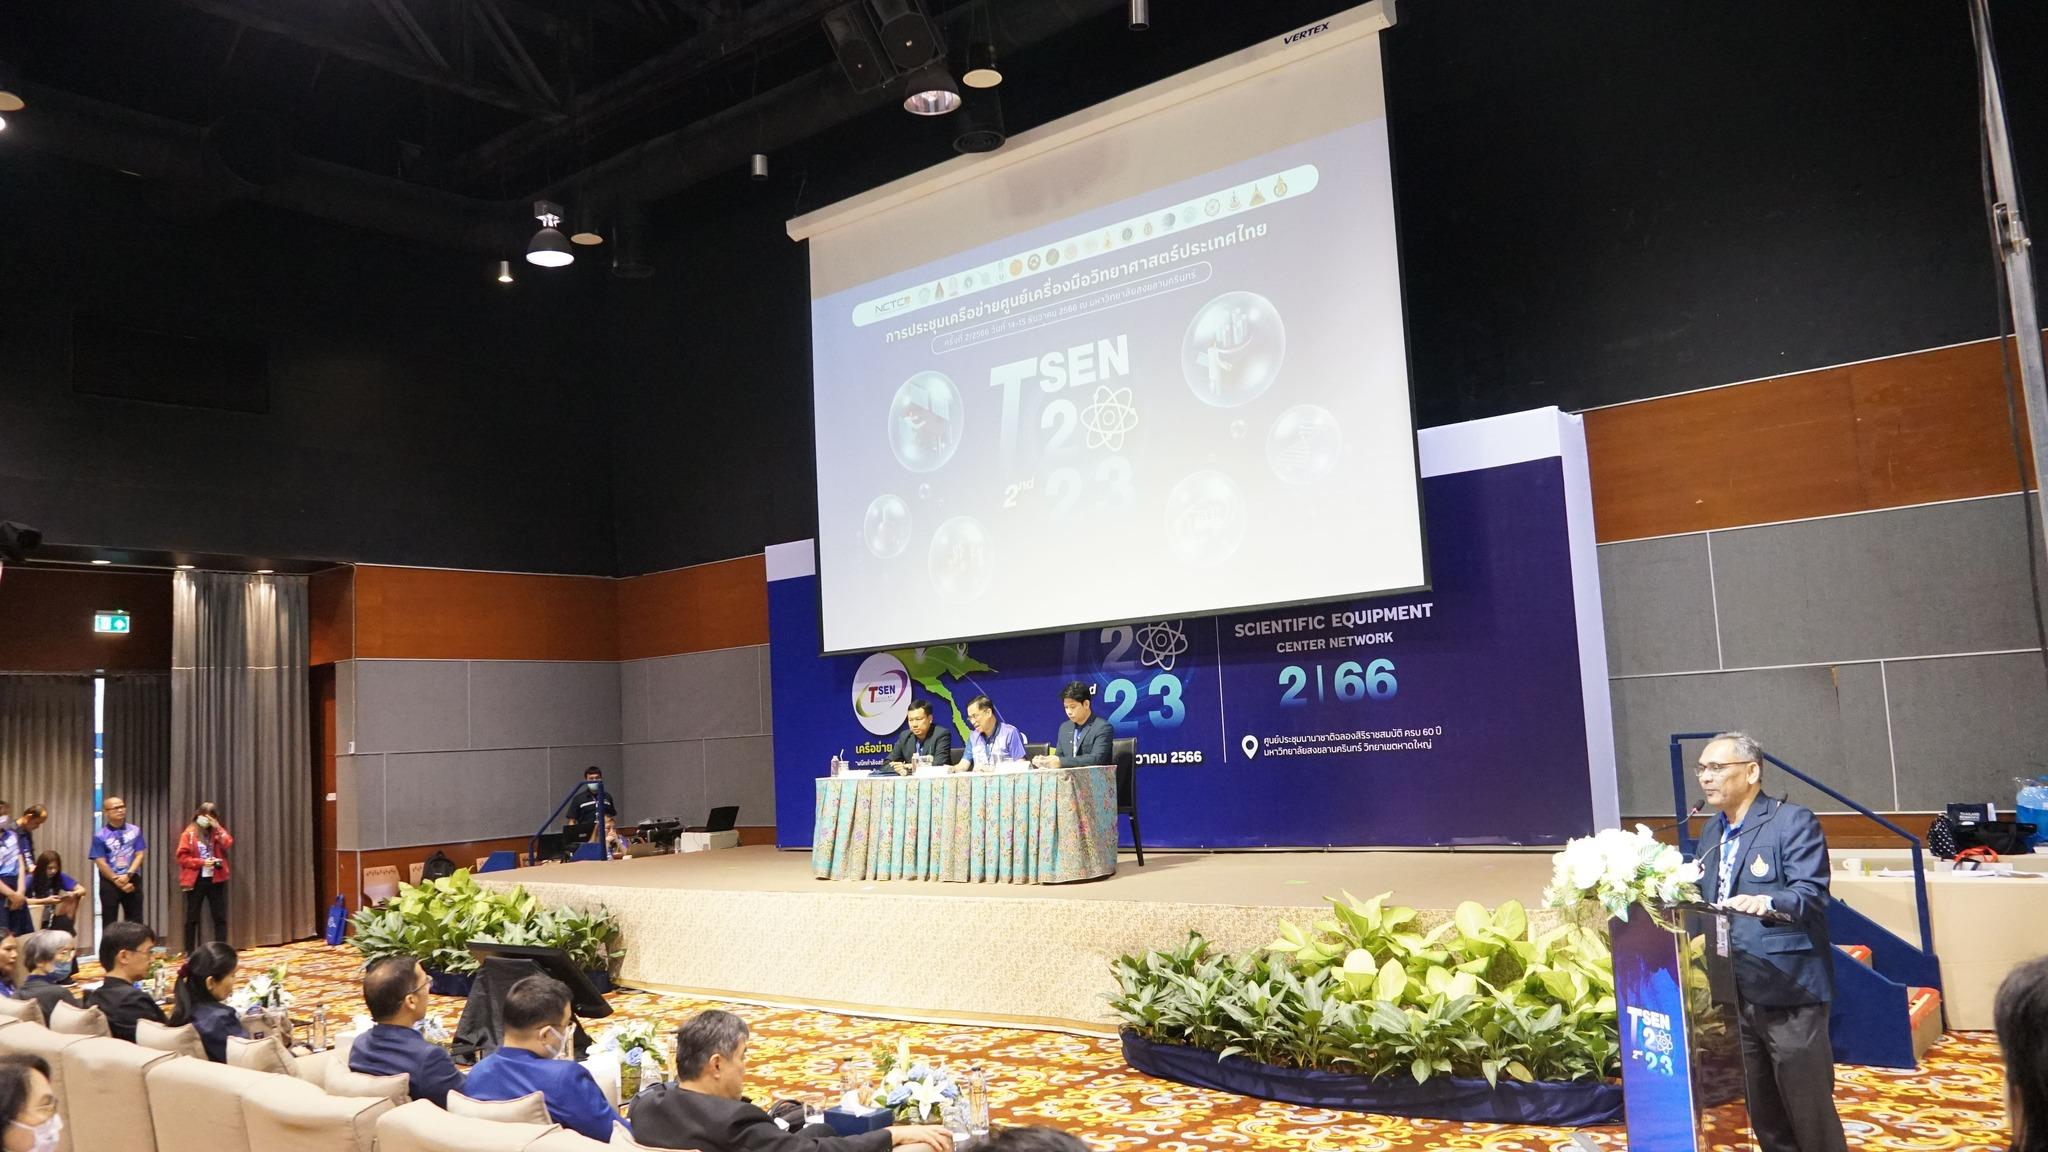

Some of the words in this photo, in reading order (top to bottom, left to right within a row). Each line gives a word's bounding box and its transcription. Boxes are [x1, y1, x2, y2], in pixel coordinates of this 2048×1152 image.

[1283, 21, 1330, 45] VERTEX
[885, 222, 1268, 343] การประชุมเครือข่ายศูนย์เครื่องมือวิทยาศาสตร์ประเทศไทย
[1234, 615, 1325, 637] SCIENTIFIC
[1331, 602, 1434, 629] EQUIPMENT
[1276, 638, 1326, 653] CENTER
[1329, 631, 1394, 649] NETWORK
[868, 684, 896, 703] TSEN
[1404, 729, 1421, 738] ครบ
[1422, 727, 1435, 737] 60
[1435, 725, 1442, 736] ปี
[1363, 739, 1432, 752] วิทยาเขตหาดใหญ่
[1135, 752, 1167, 764] วาคม
[1171, 751, 1202, 764] 2566
[1627, 1006, 1670, 1046] TSEN
